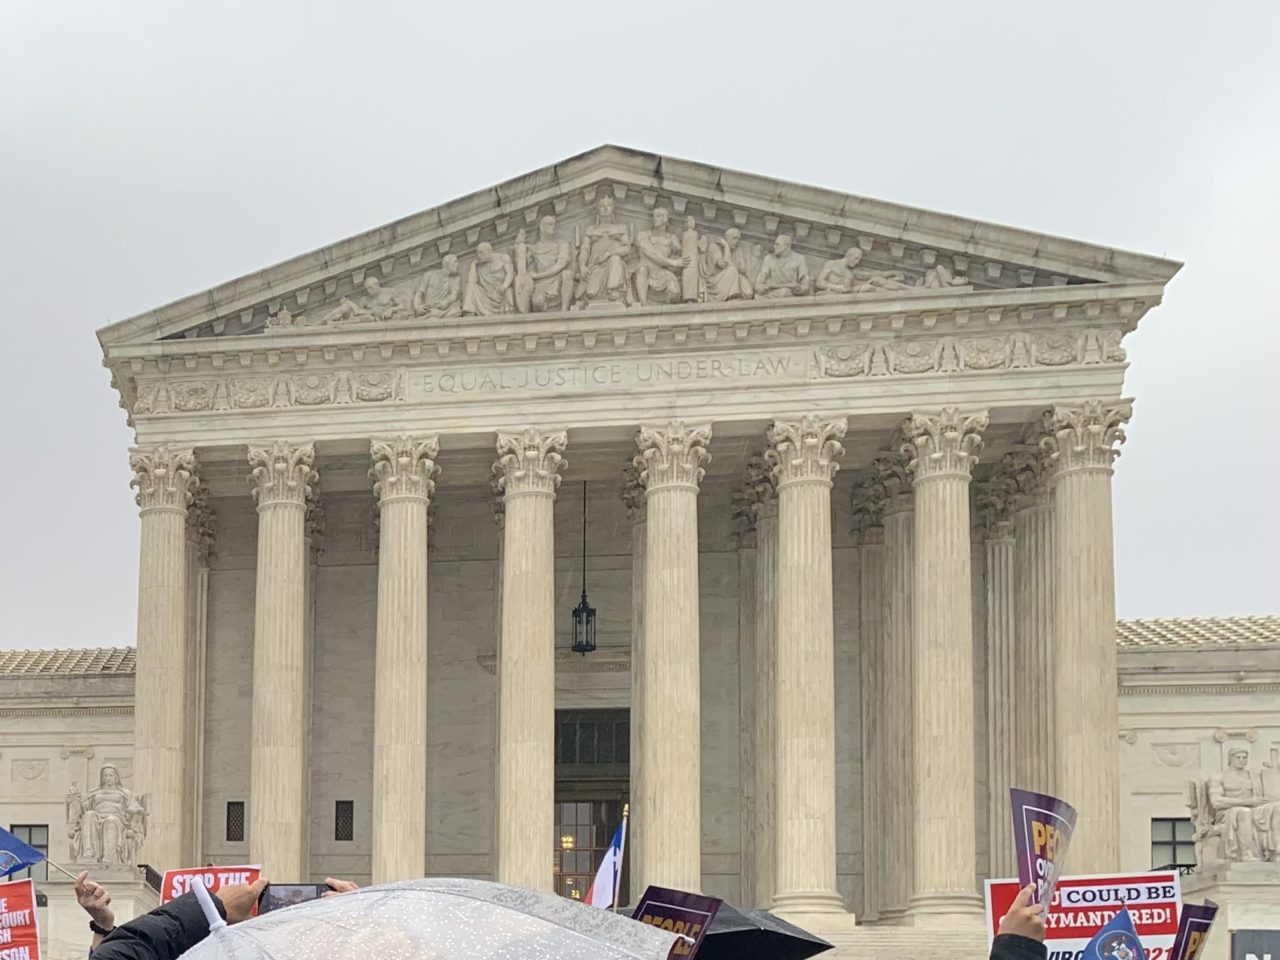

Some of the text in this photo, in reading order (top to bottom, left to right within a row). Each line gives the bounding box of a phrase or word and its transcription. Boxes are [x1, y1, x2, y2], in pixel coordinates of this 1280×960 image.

[423, 355, 791, 393] EQUAL JUSTICE UNDER LAW
[1032, 820, 1064, 863] PEO
[1067, 887, 1141, 904] COULD
[1146, 885, 1176, 900] BE
[1044, 907, 1172, 928] YMANDRED!
